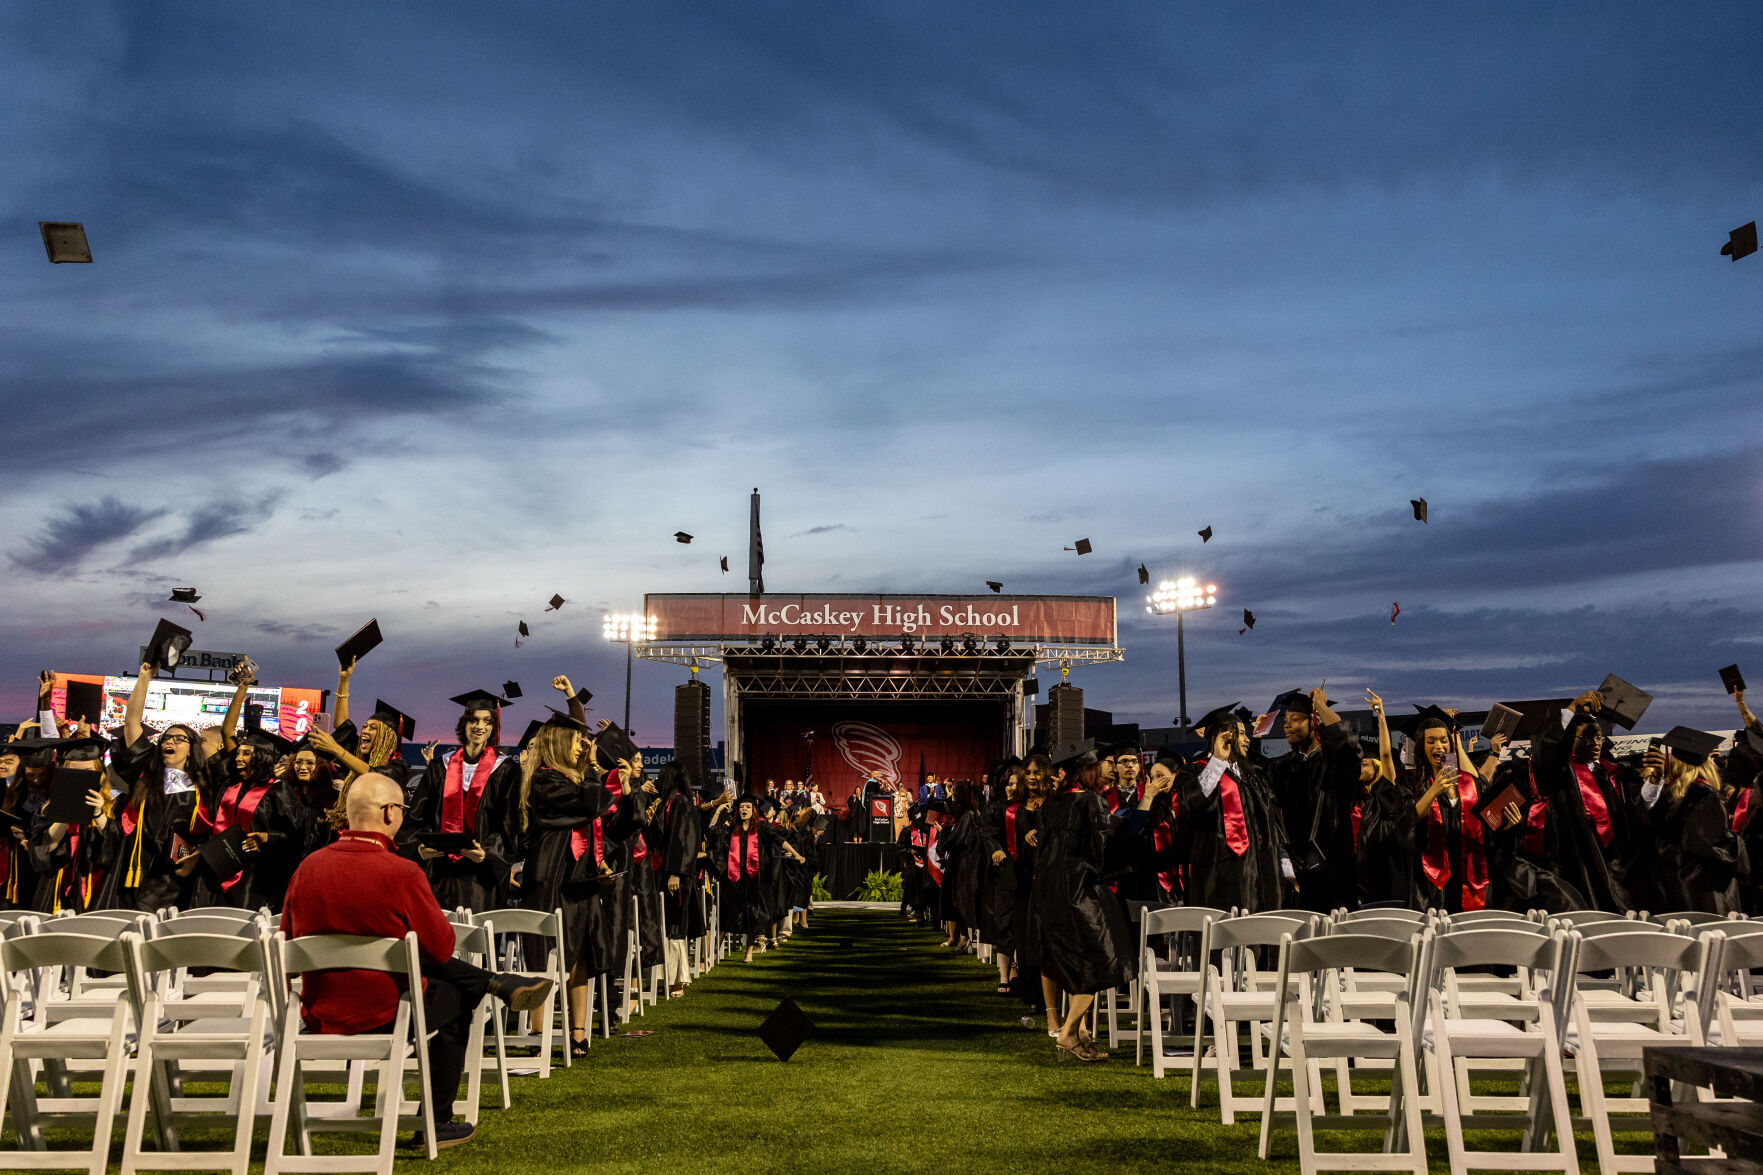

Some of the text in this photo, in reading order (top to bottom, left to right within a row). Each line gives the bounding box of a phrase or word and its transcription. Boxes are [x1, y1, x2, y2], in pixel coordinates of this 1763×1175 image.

[741, 603, 1020, 633] McCaskey High School
[201, 653, 240, 668] Bank
